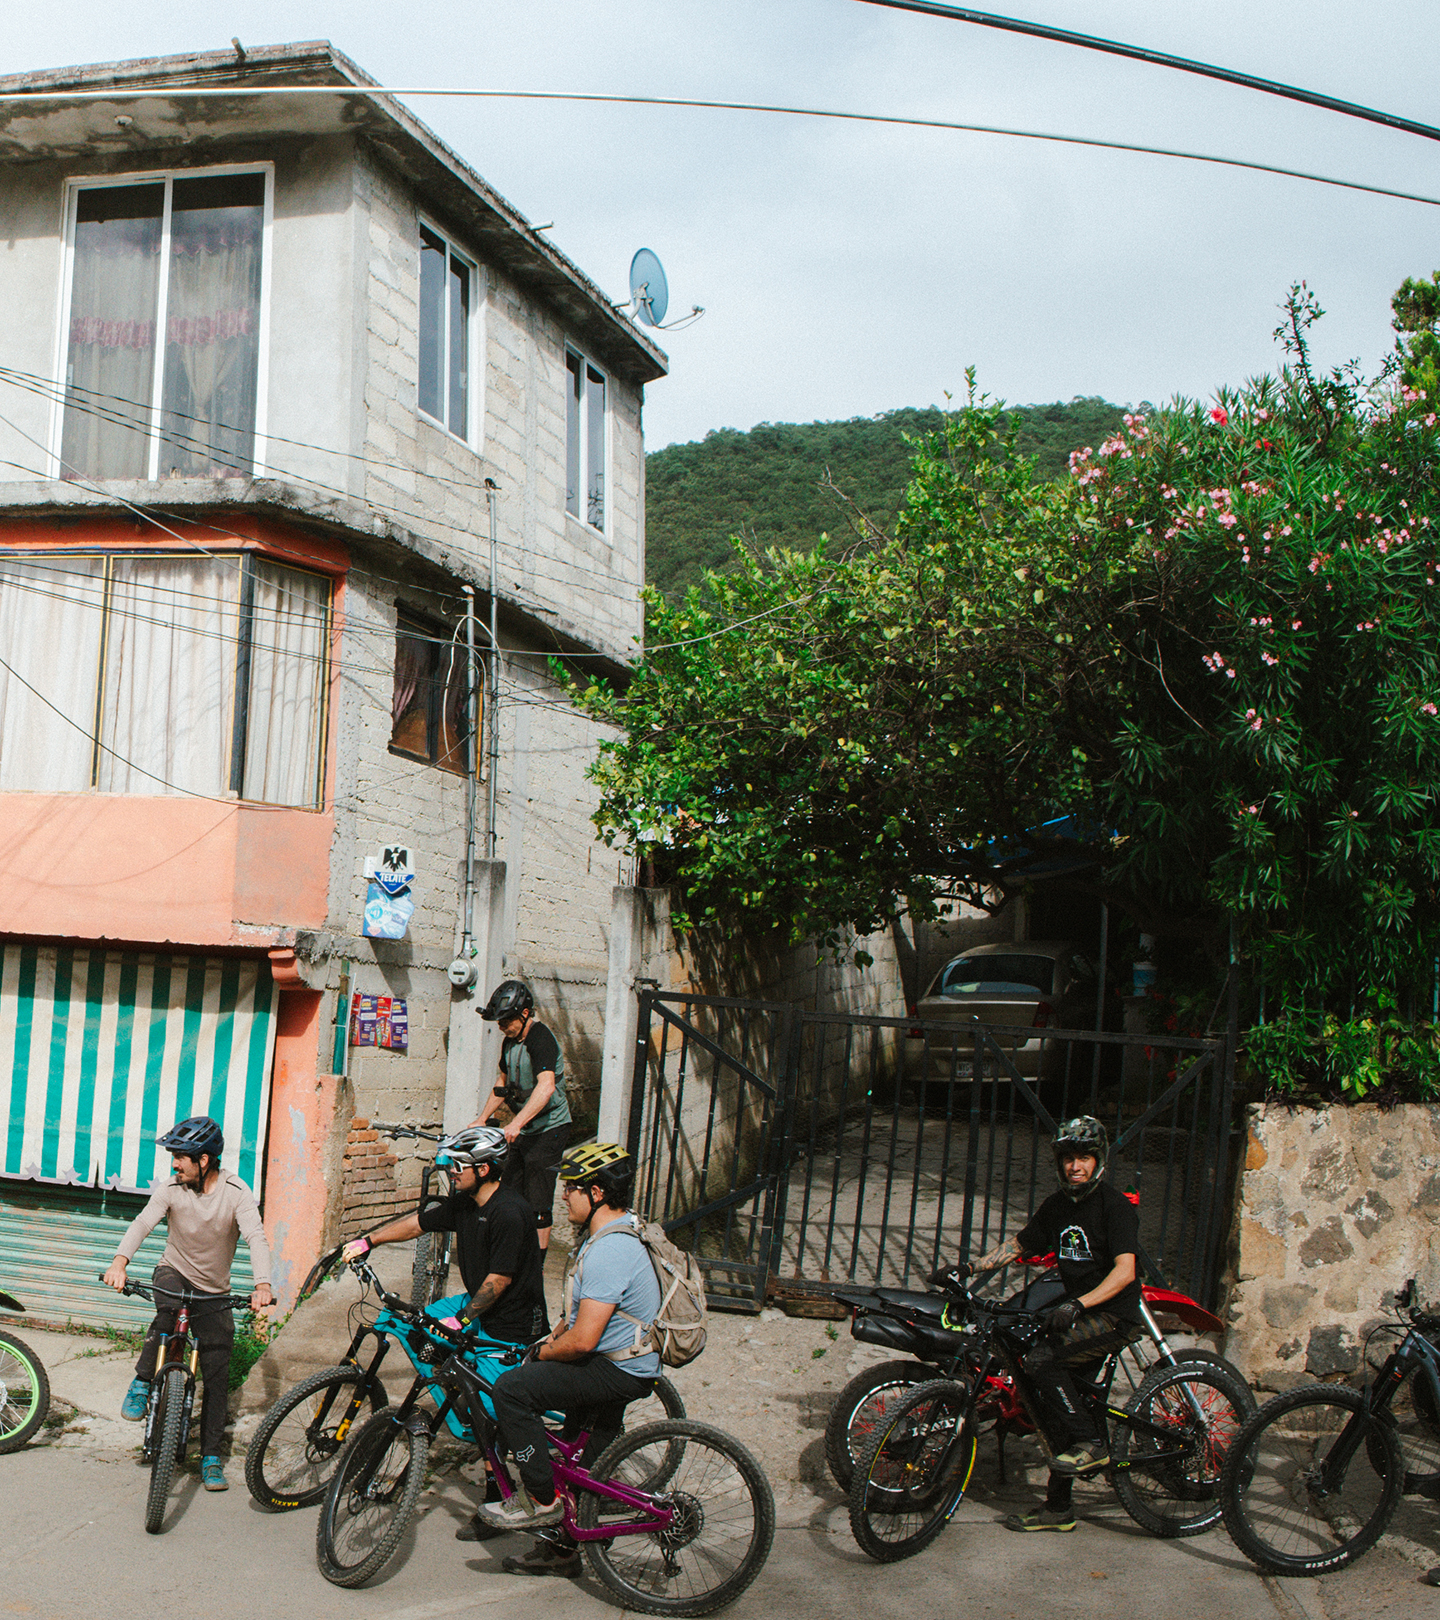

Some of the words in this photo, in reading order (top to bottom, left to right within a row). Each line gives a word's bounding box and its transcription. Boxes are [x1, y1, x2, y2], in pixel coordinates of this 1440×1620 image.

[380, 872, 408, 883] TECATE
[271, 1498, 299, 1507] MAXXIS
[1305, 1551, 1348, 1569] MAXXIS
